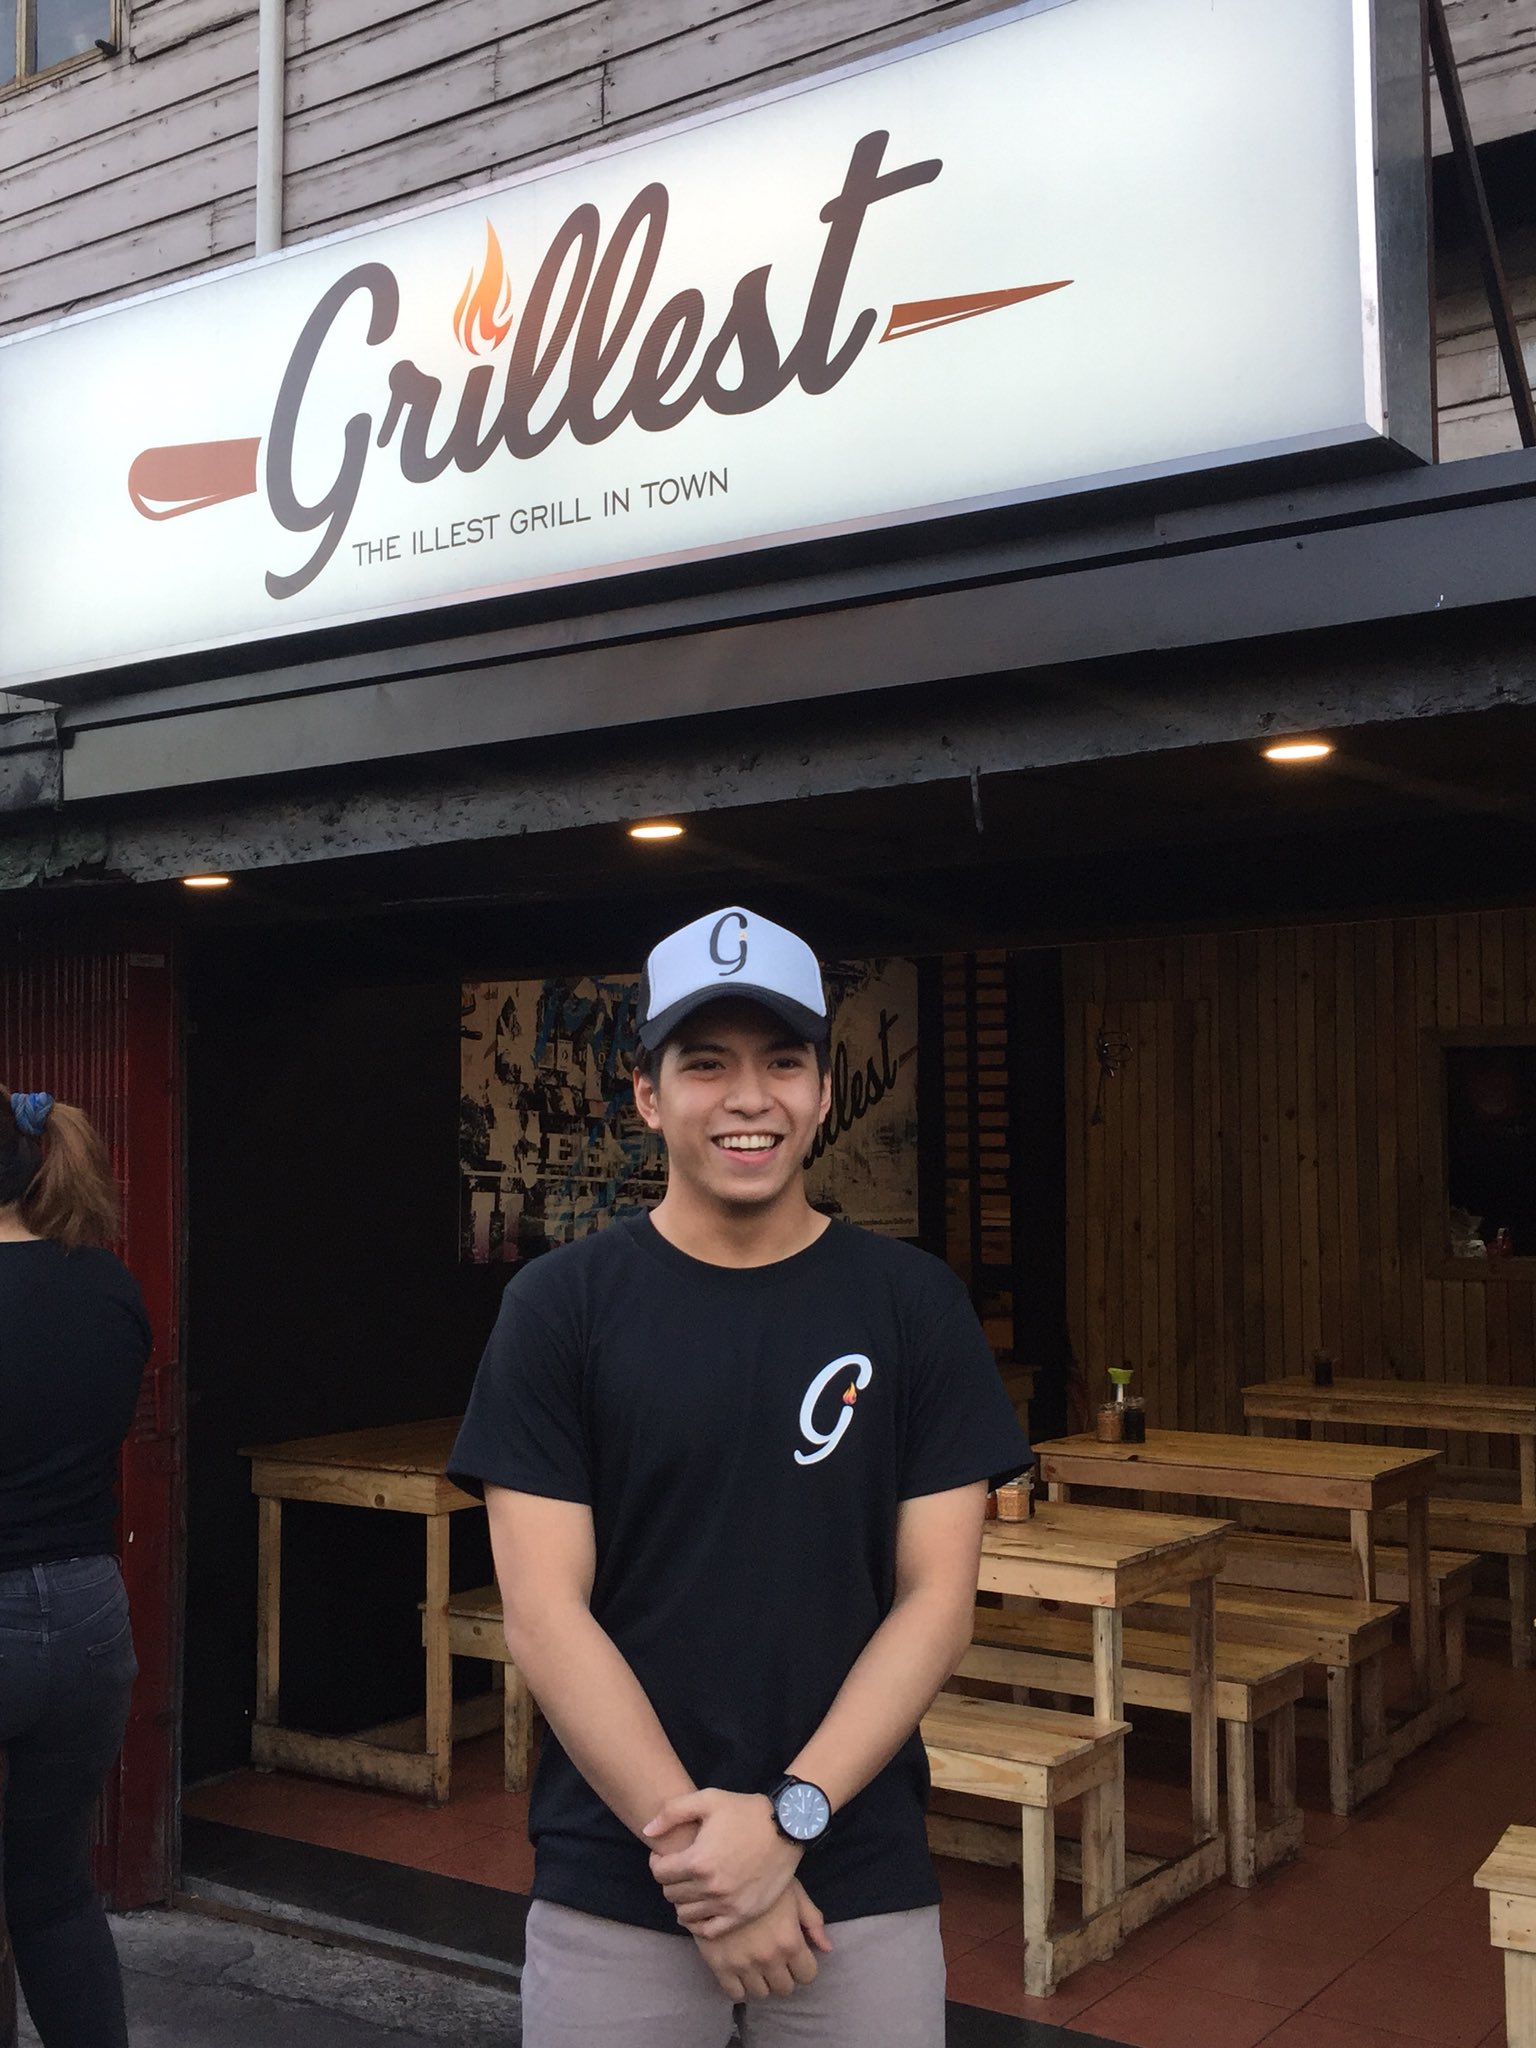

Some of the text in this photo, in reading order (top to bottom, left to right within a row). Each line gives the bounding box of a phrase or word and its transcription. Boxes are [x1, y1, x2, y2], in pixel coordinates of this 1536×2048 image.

[264, 129, 943, 600] Grillest
[352, 467, 729, 566] THE ILLEST GRILL IN TOWN
[793, 1353, 873, 1465] G
